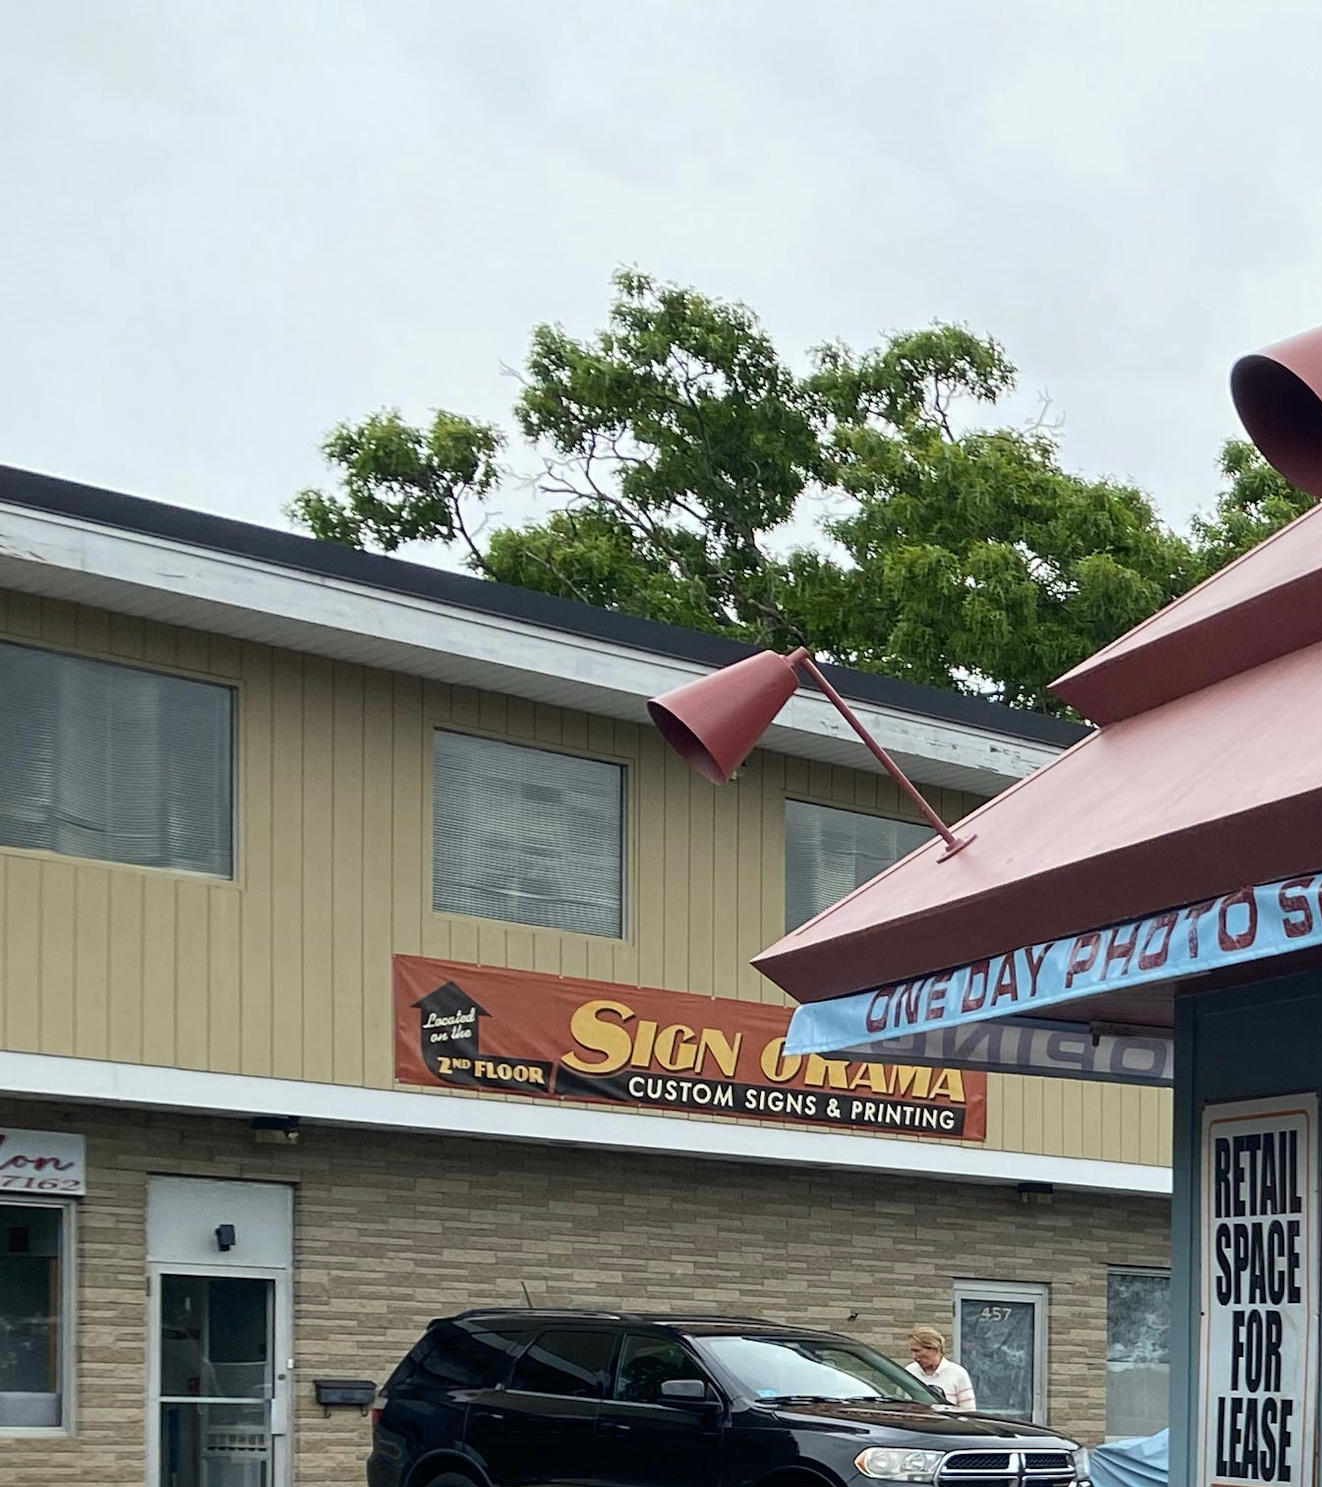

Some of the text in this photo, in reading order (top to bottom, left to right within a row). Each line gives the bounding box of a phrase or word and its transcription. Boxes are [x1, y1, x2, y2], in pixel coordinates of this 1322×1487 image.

[865, 972, 951, 1036] ONE
[960, 942, 1069, 1013] DAY
[1064, 888, 1259, 992] PHOTO
[422, 1006, 477, 1029] Located
[430, 1025, 473, 1043] on the
[560, 999, 967, 1103] SIGN ORAMA
[437, 1056, 546, 1085] 2ND FLOOR
[628, 1075, 956, 1131] CUSTOM SIGNS & PRINTING
[1213, 1129, 1304, 1219] RETAIL
[1214, 1216, 1302, 1305] SPACE
[980, 1306, 1013, 1321] 457
[1229, 1309, 1283, 1393] FOR
[1214, 1395, 1293, 1483] LEASE
